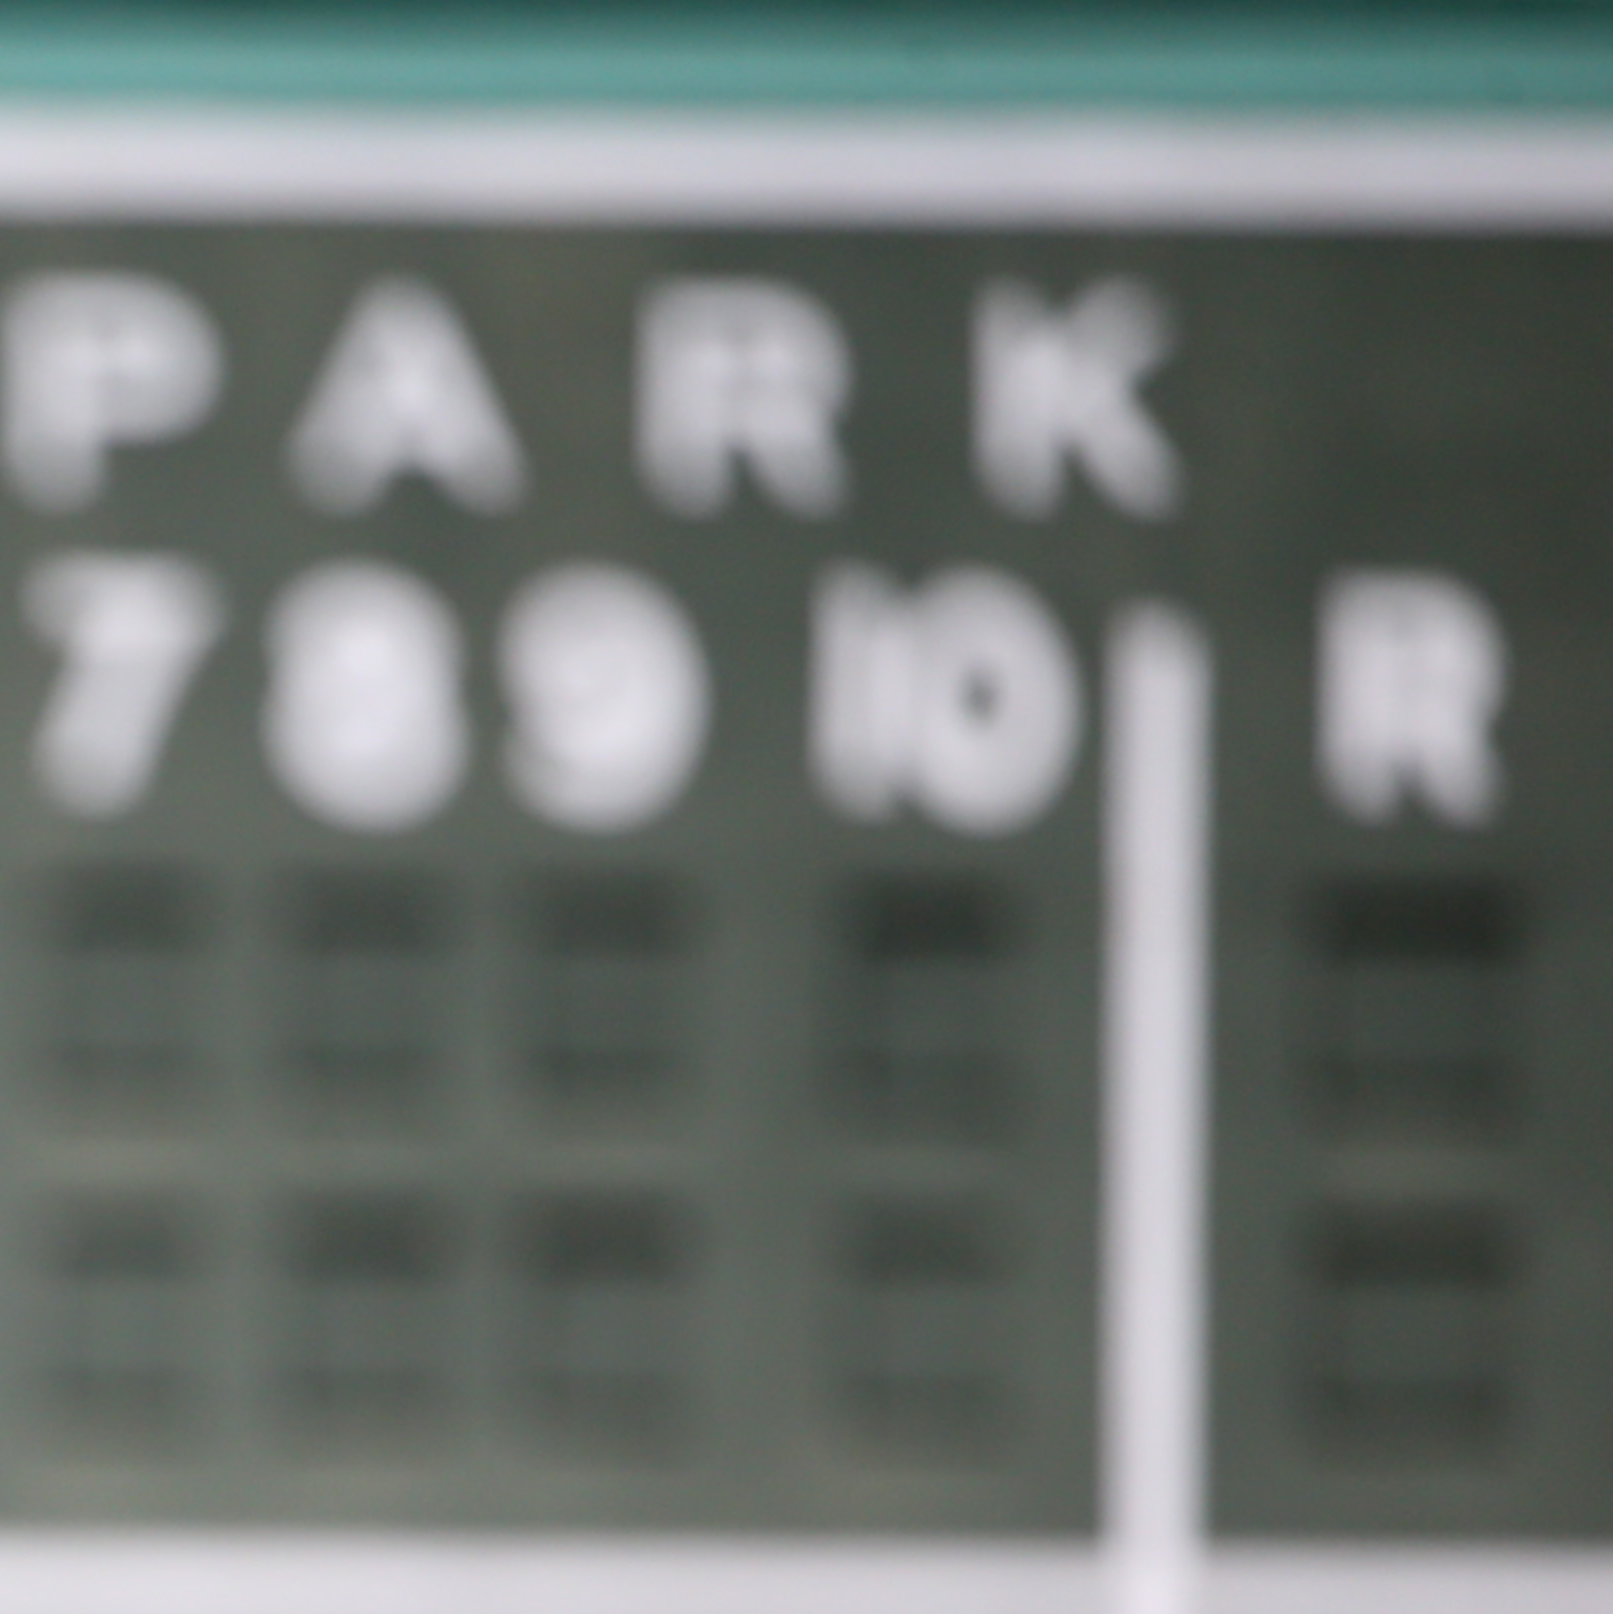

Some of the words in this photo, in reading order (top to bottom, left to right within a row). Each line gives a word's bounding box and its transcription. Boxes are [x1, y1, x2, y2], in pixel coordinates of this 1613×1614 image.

[25, 550, 221, 817] 7
[263, 562, 468, 831] 8
[498, 564, 708, 833] 9
[806, 567, 1083, 835] 10
[1314, 570, 1506, 824] R
